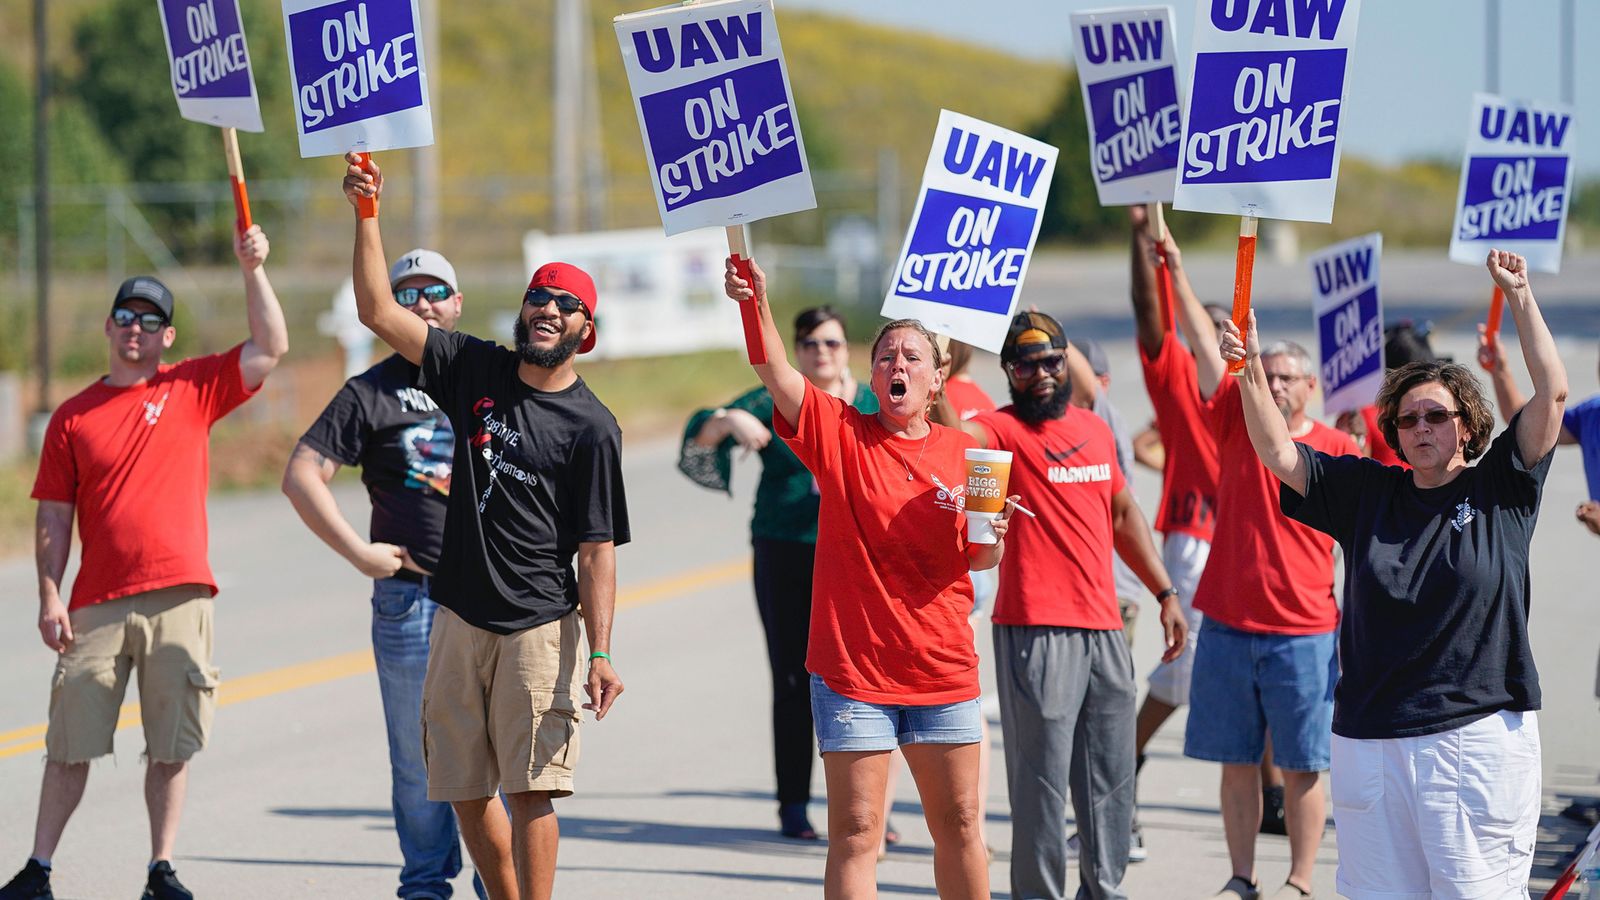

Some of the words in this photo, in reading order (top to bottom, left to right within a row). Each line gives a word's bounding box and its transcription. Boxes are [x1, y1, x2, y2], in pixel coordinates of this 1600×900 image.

[186, 0, 218, 44] ON
[322, 2, 371, 63] ON
[631, 11, 762, 74] UAW
[1080, 19, 1163, 64] UAW
[1210, 0, 1346, 41] UAW
[175, 33, 248, 96] STRIKE
[301, 32, 418, 128] STRIKE
[1233, 57, 1296, 114] ON
[684, 78, 741, 140] ON
[1112, 76, 1146, 127] ON
[1479, 104, 1571, 148] UAW
[660, 103, 795, 205] STRIKE
[943, 127, 1047, 198] UAW
[1096, 103, 1181, 181] STRIKE
[1186, 99, 1340, 178] STRIKE
[1491, 157, 1536, 200] ON
[946, 205, 1002, 248] ON
[1459, 186, 1564, 240] STRIKE
[897, 247, 1027, 293] STRIKE
[1315, 248, 1372, 296] UAW
[1334, 298, 1361, 347] ON
[1322, 315, 1381, 398] STRIKE
[965, 486, 1000, 499] SWIGG
[968, 475, 997, 488] BIGG
[1048, 463, 1111, 484] NASHVILLE
